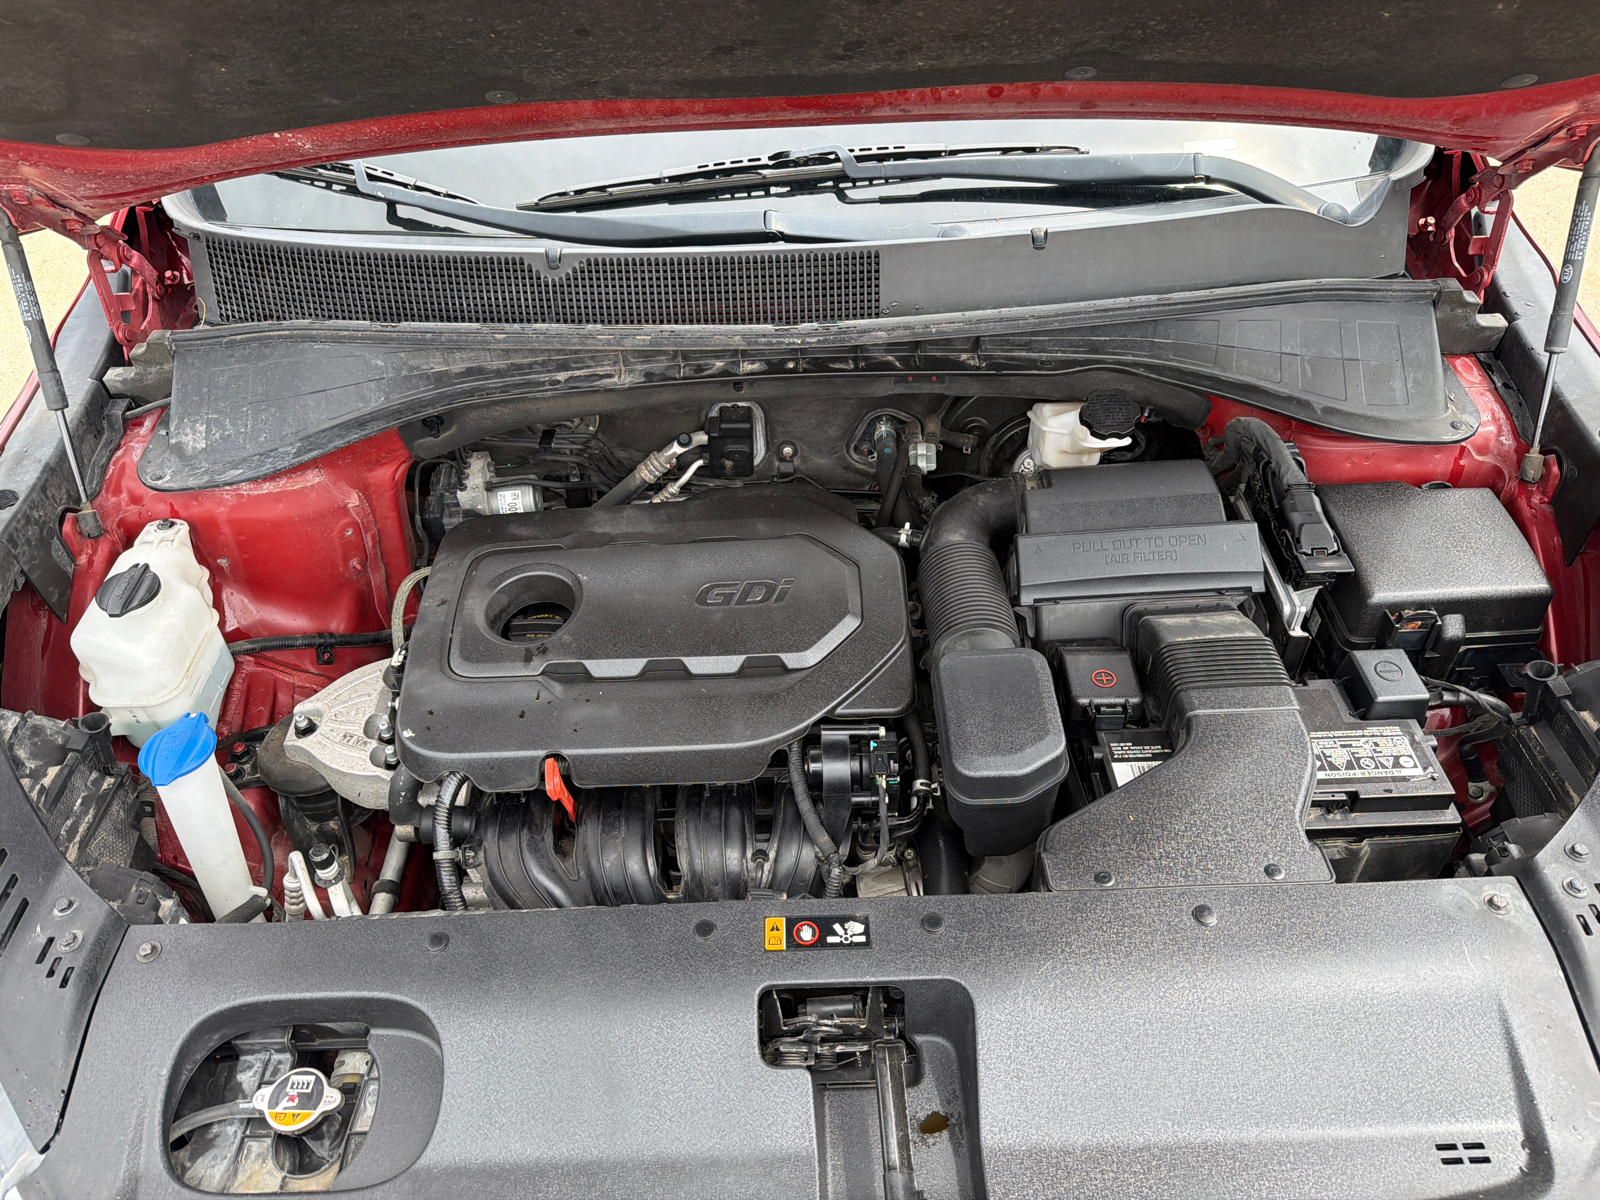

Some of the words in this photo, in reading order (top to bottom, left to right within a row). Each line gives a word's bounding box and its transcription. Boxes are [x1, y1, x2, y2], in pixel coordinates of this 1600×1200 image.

[1072, 540, 1108, 553] PULL
[1112, 537, 1140, 550] OUT
[1144, 536, 1164, 549] TO
[1168, 533, 1207, 547] OPEN
[1104, 552, 1130, 565] (AIR
[1133, 549, 1178, 563] FILTER)
[694, 578, 795, 607] GDi
